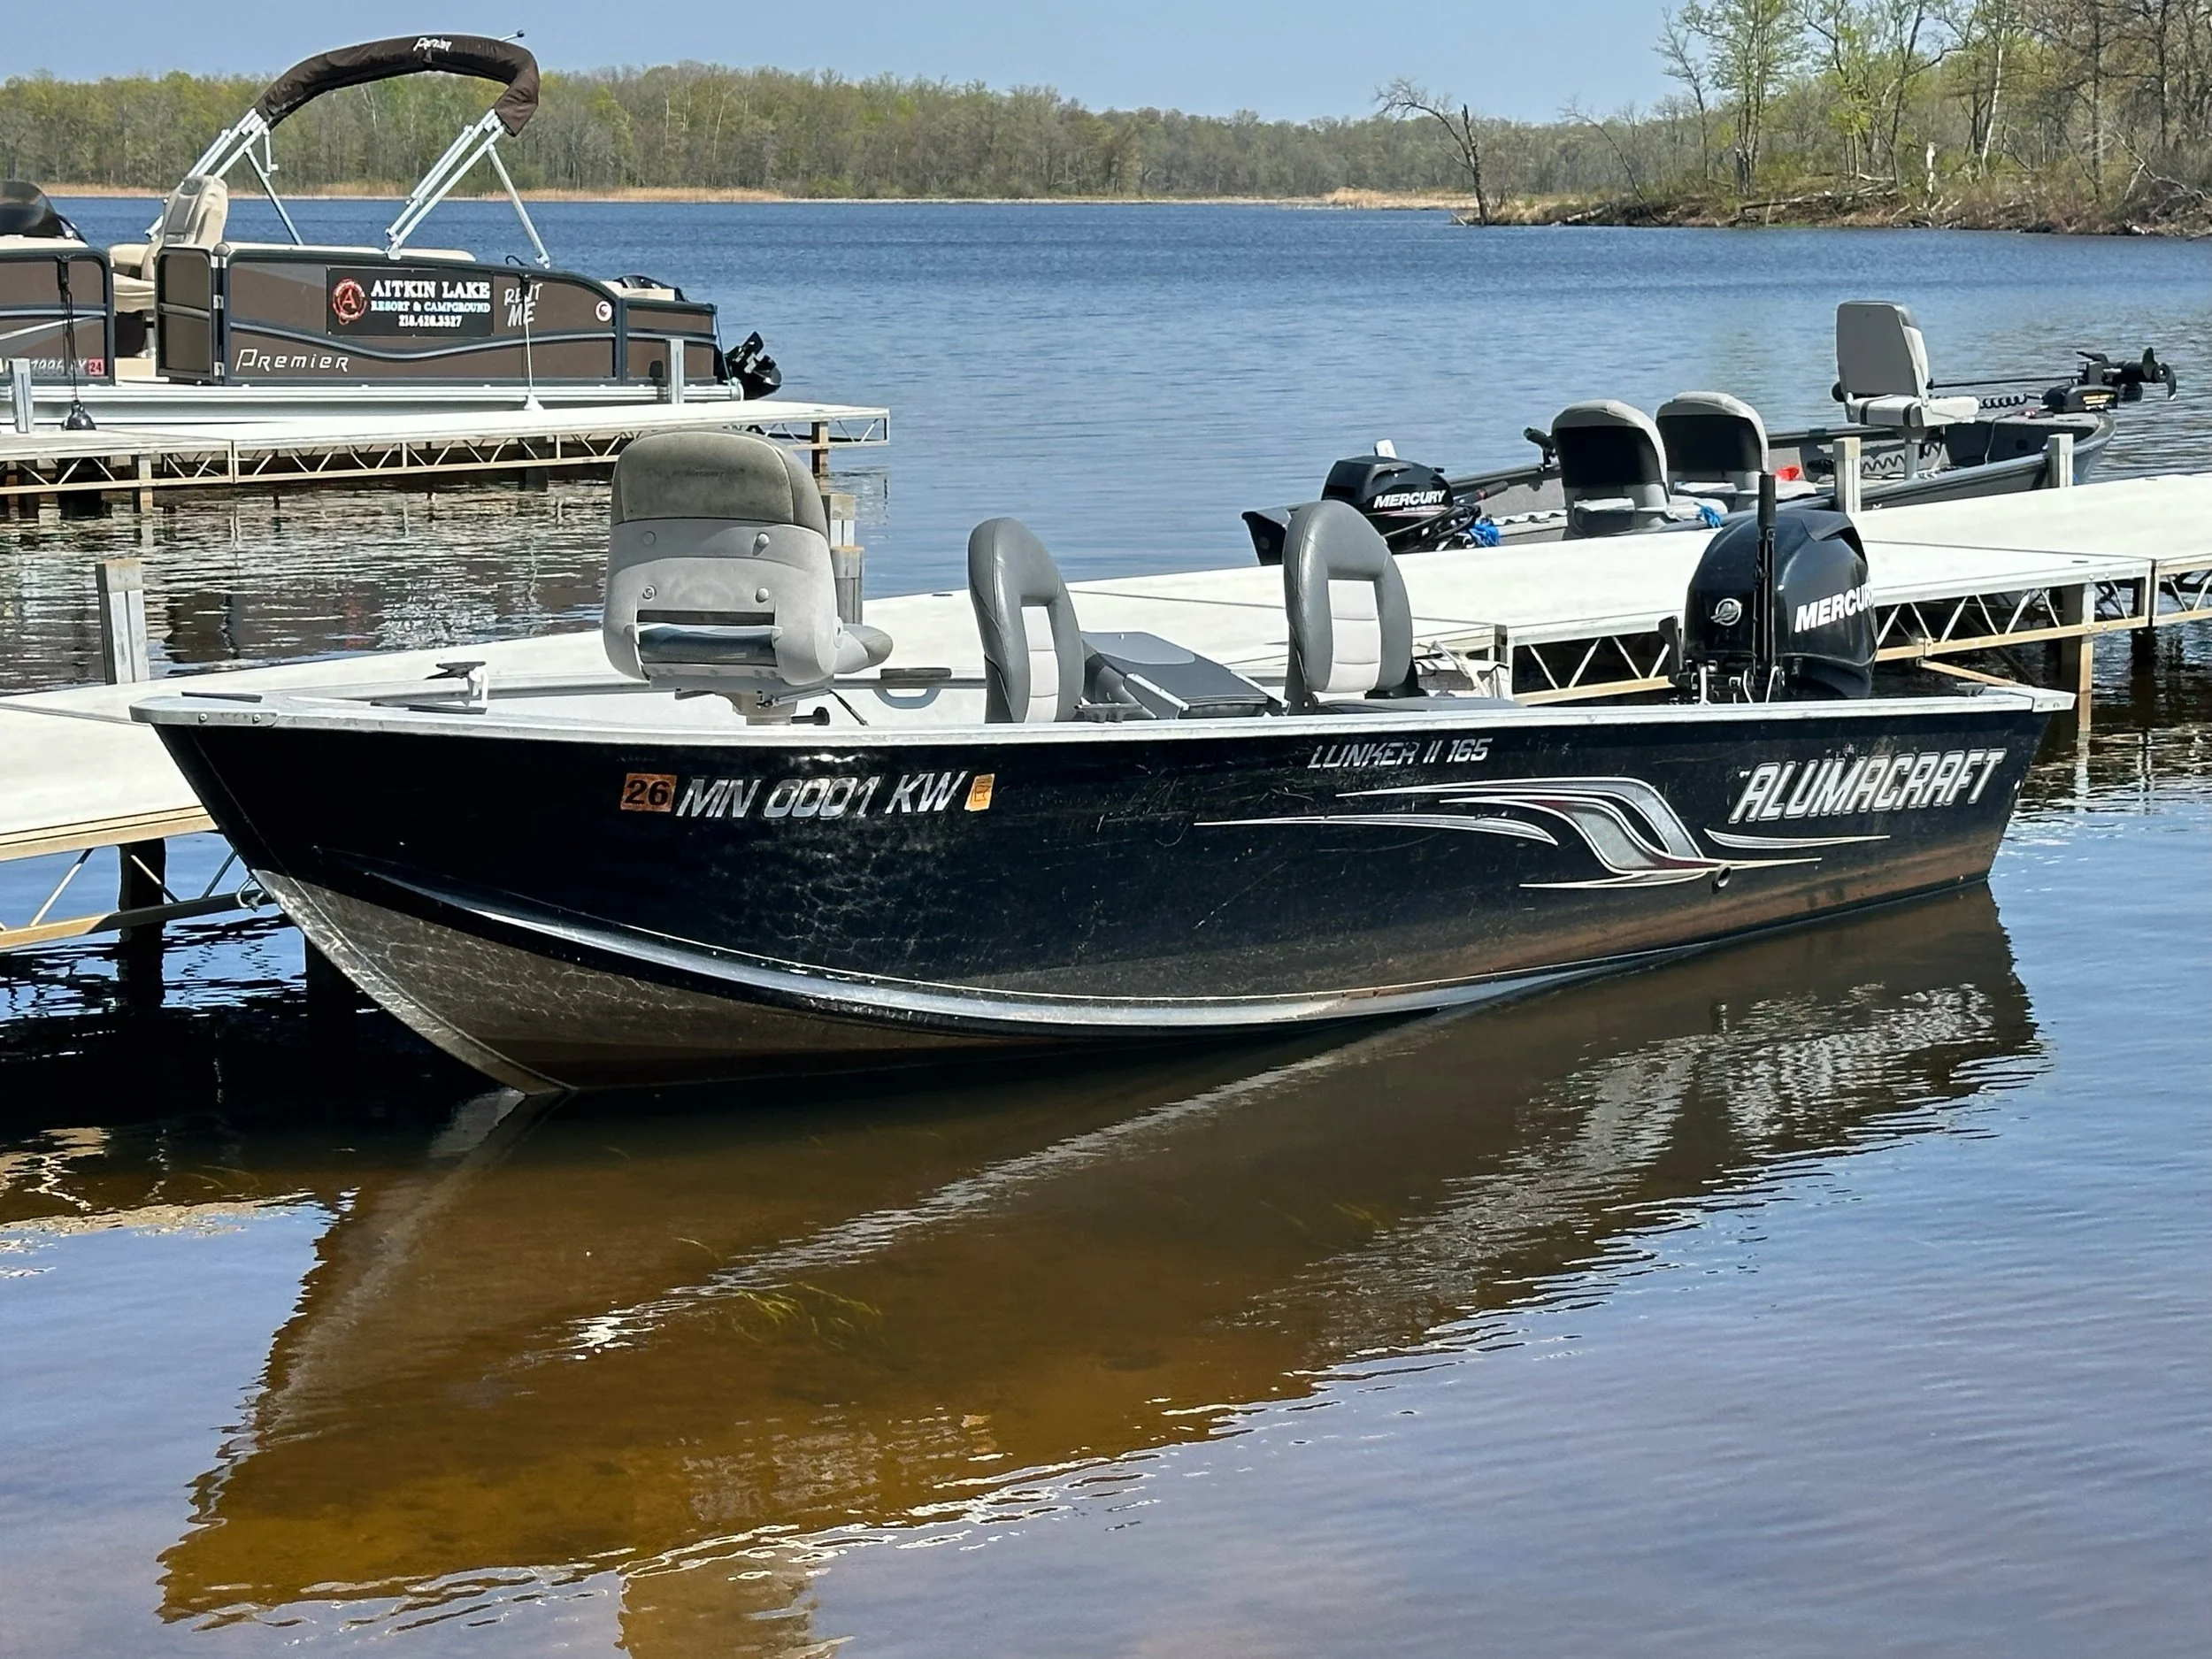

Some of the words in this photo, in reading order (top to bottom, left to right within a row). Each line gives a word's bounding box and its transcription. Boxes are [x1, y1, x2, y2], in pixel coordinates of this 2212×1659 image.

[370, 280, 436, 298] AITKIN
[442, 281, 491, 299] LAKE
[370, 300, 411, 311] RESORT
[424, 302, 491, 313] CAMPGROUND
[507, 301, 536, 327] ME
[89, 362, 103, 373] 24
[1373, 489, 1447, 510] MERCURY
[1307, 742, 1419, 769] LUNKER
[1423, 740, 1444, 763] II
[1446, 737, 1494, 764] 165
[626, 779, 669, 806] 26
[676, 778, 760, 818] MN
[763, 776, 882, 819] 0001
[885, 771, 969, 815] KW
[1728, 749, 2007, 824] ALUMACRAFT
